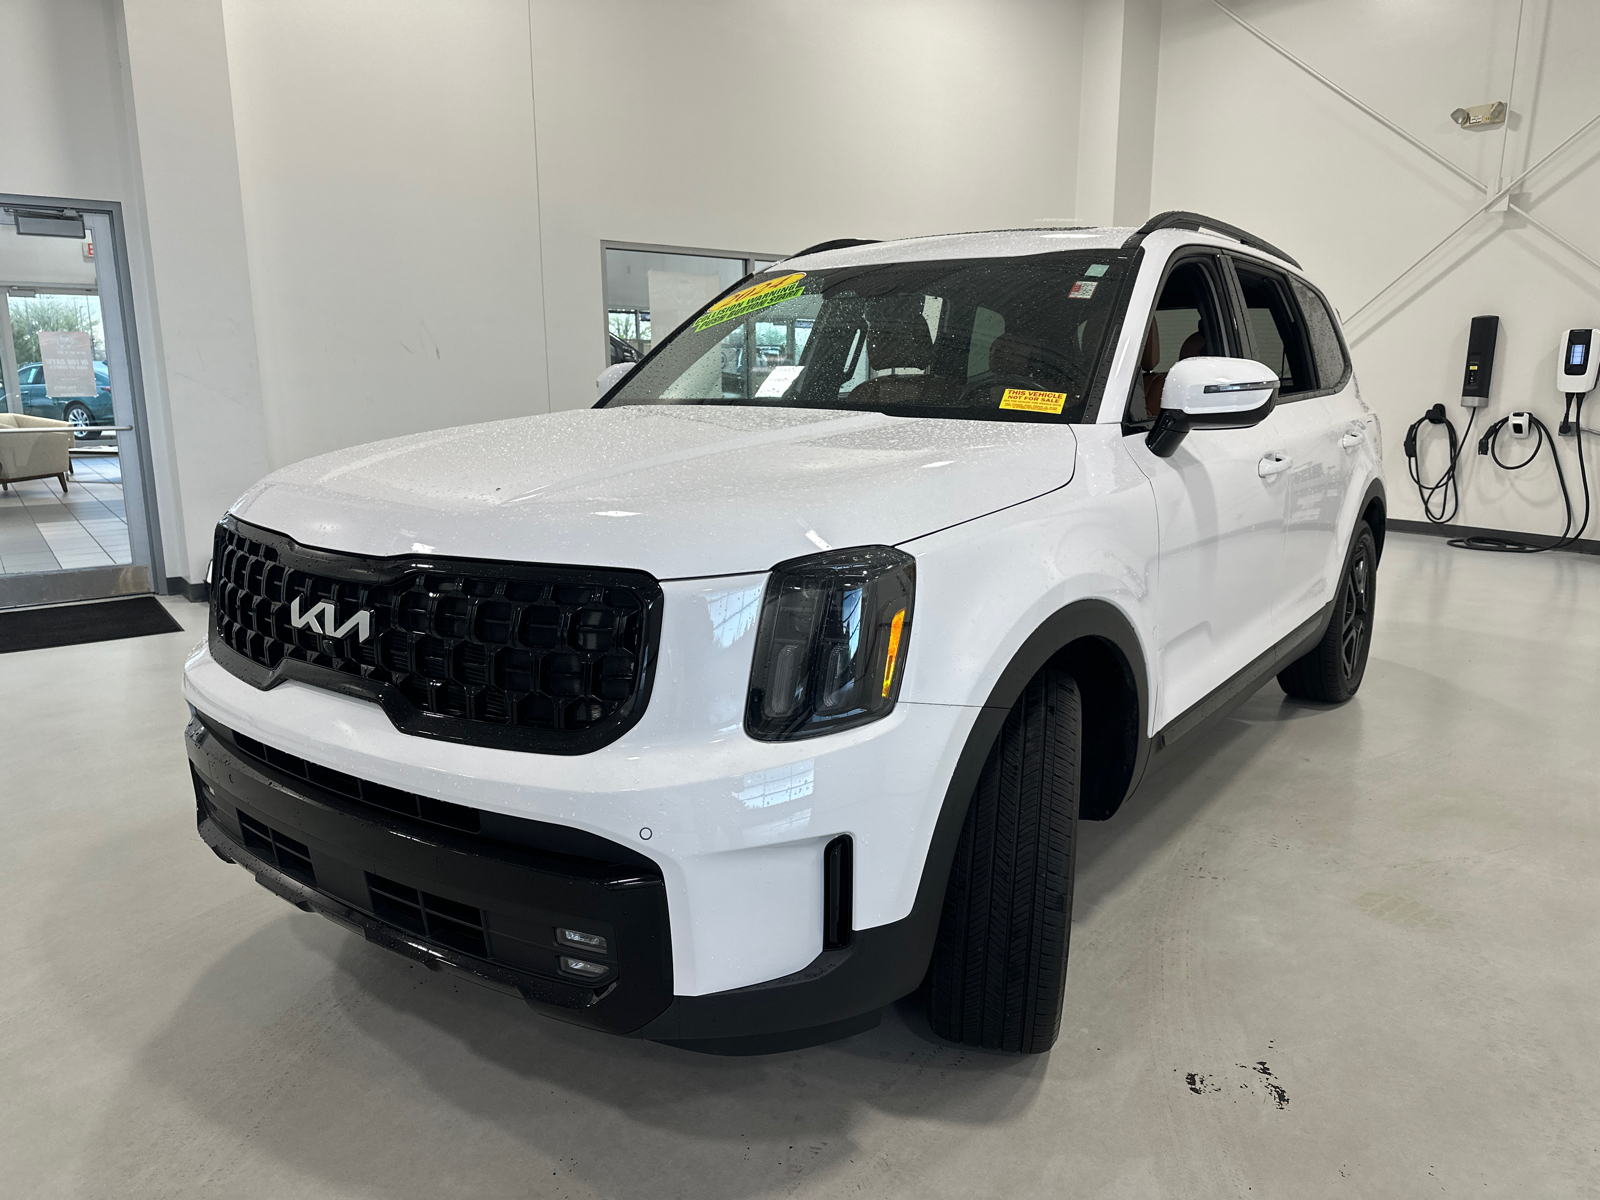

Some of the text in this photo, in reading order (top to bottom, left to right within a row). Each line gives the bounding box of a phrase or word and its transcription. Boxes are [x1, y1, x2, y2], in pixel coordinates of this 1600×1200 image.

[694, 281, 799, 326] COLLISION WARNING
[698, 286, 804, 330] PUSH BUTTON START
[1028, 391, 1064, 400] VEHICLE
[290, 595, 371, 644] KIA
